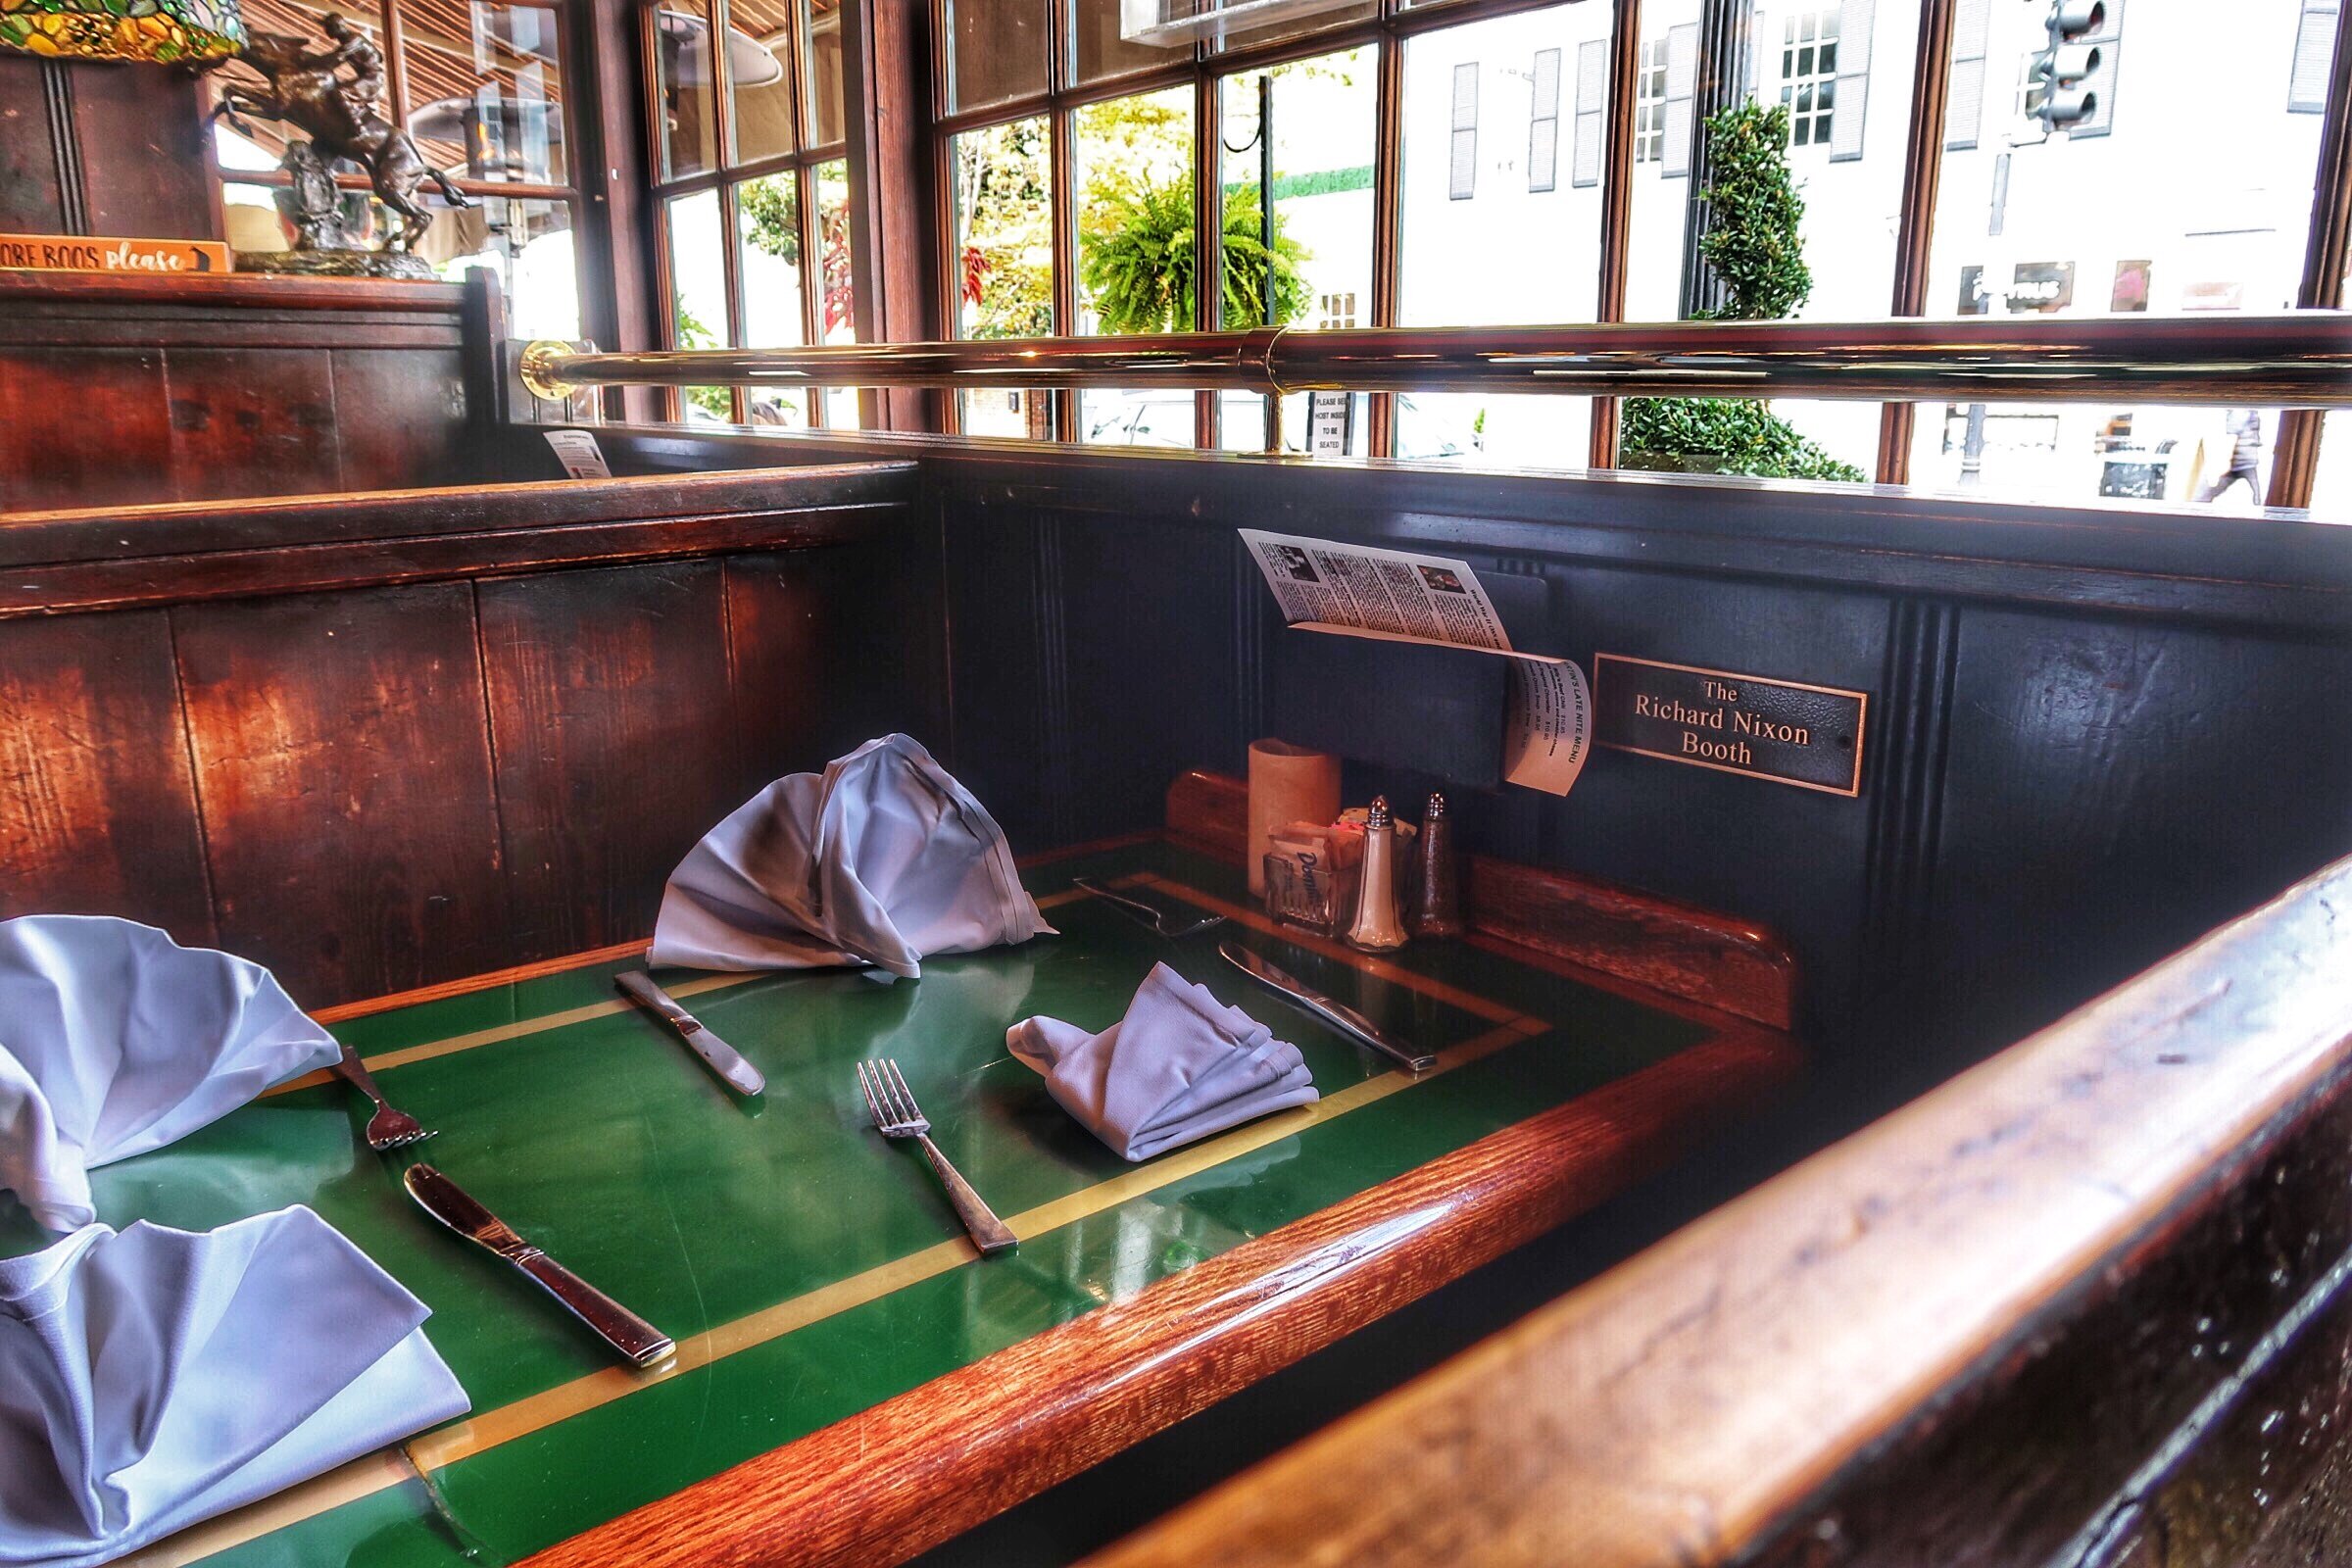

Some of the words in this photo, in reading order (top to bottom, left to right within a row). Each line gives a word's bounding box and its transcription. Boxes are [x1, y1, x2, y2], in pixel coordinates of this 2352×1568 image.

[42, 244, 99, 269] BOOS
[105, 241, 185, 271] please
[1323, 426, 1330, 435] TO
[1331, 426, 1338, 435] BE
[1574, 689, 1584, 711] LATE
[1703, 680, 1738, 702] The
[1635, 694, 1724, 730] Richard
[1734, 710, 1809, 745] Nixon
[1568, 736, 1583, 763] MENU
[1682, 731, 1752, 765] Booth
